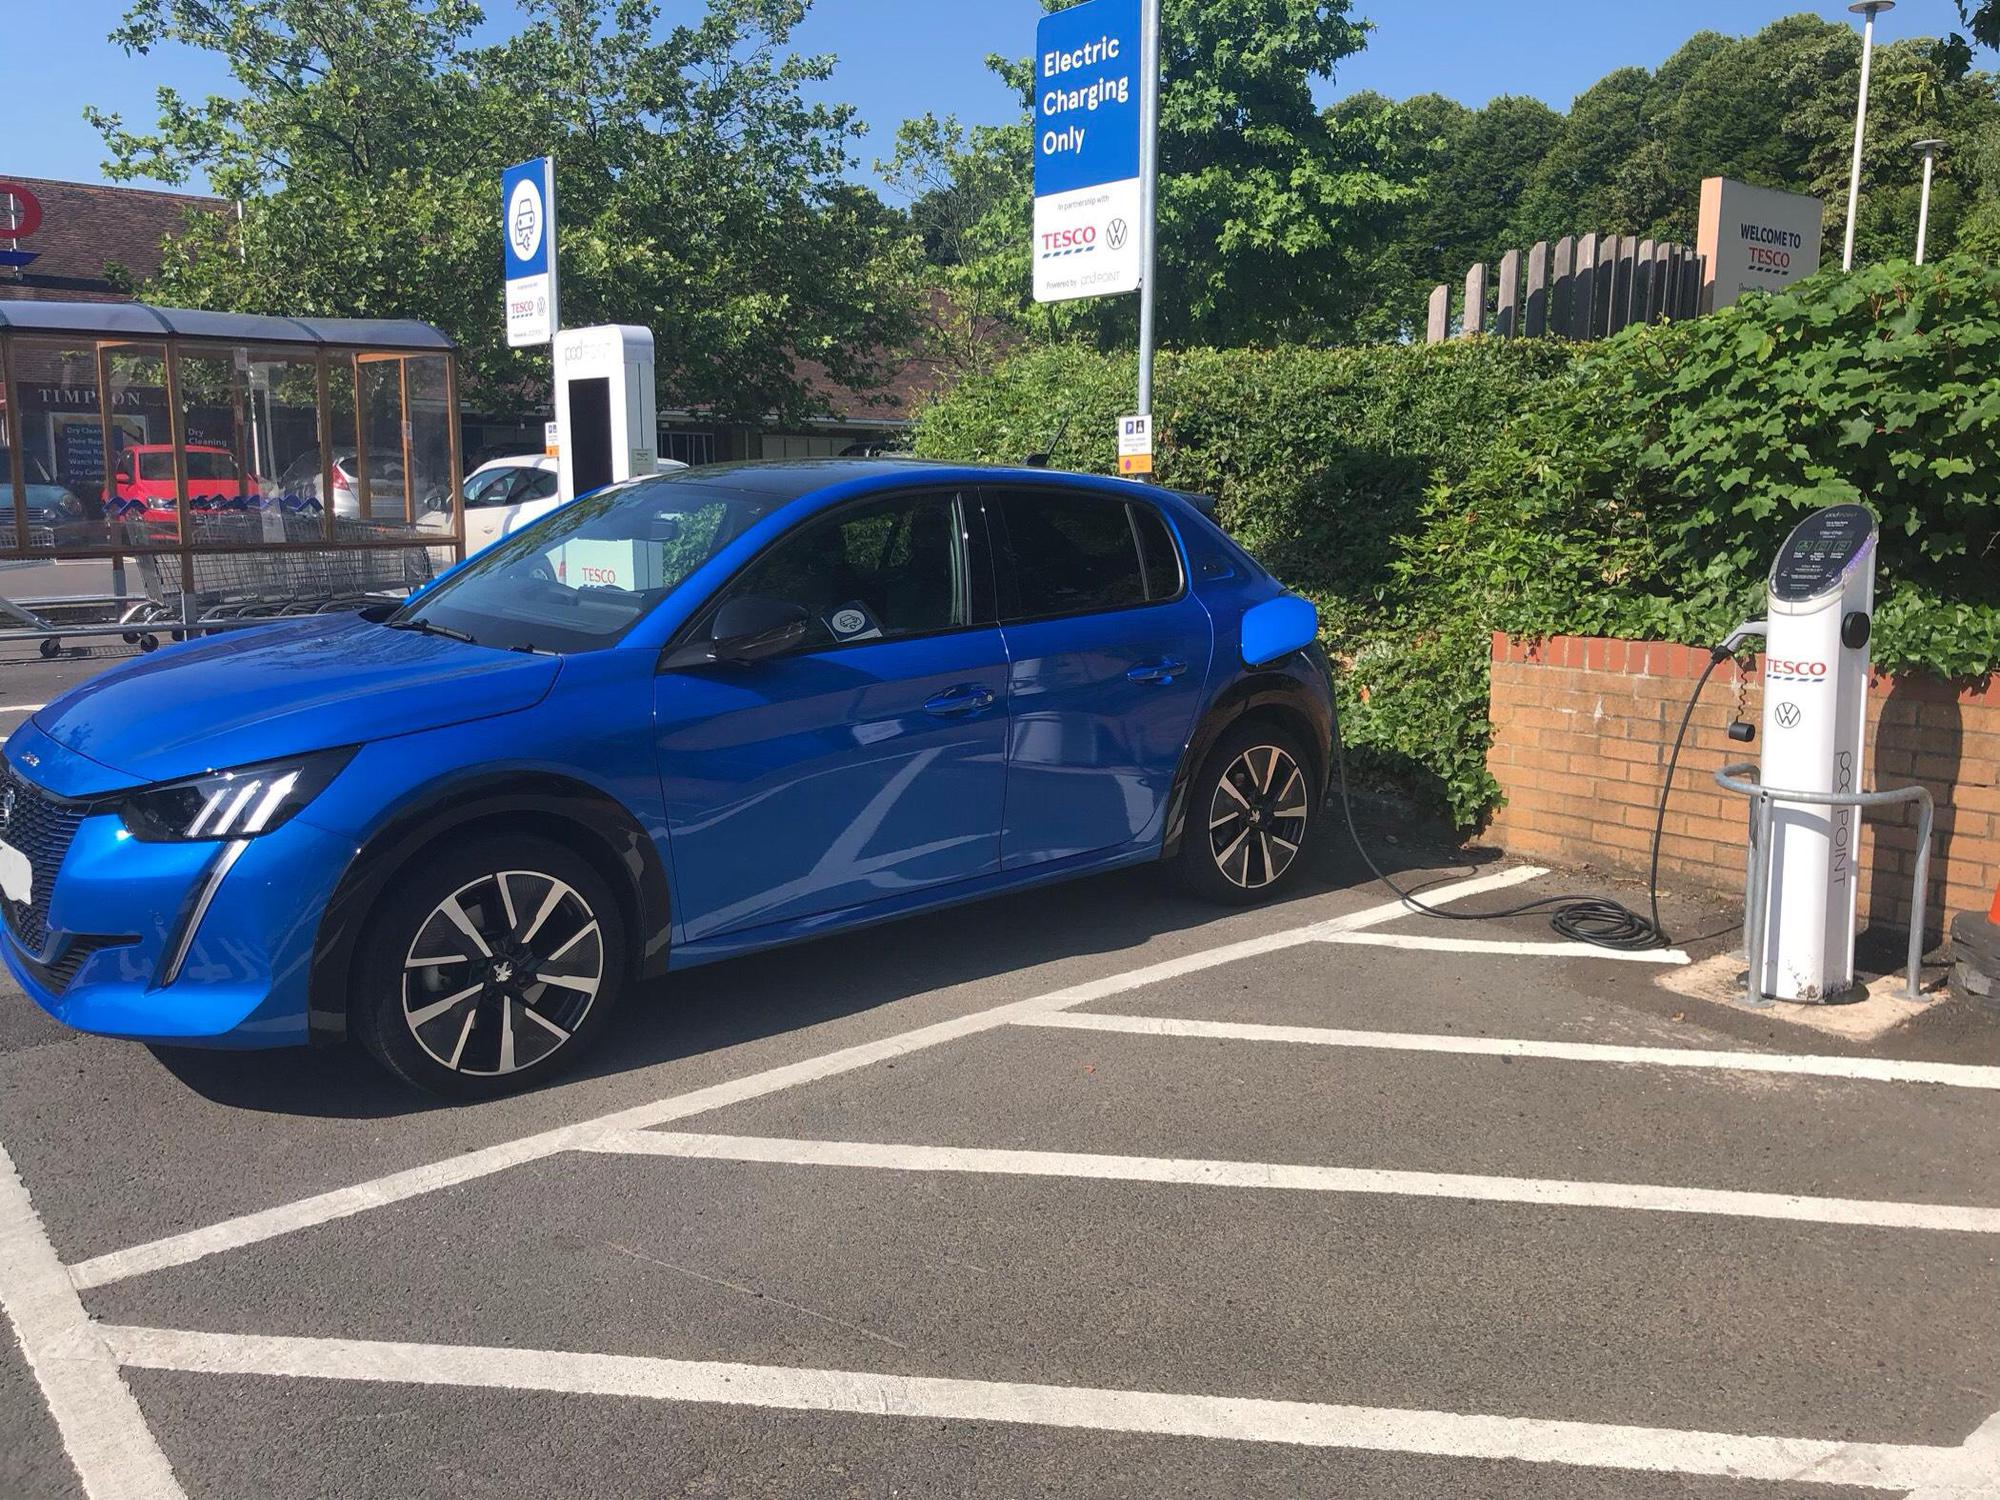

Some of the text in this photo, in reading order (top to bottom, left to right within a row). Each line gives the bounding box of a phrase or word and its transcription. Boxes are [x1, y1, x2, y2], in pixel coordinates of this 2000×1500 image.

[1044, 35, 1120, 78] Electric
[1043, 76, 1129, 116] Charging
[1042, 125, 1086, 155] Only
[1041, 226, 1097, 250] TESCO
[1740, 223, 1802, 249] WELCOME TO
[1748, 246, 1791, 268] TESCO
[511, 300, 535, 313] TESCO
[38, 388, 142, 407] TIMPON
[188, 428, 204, 438] Dry
[188, 437, 227, 447] Cleaning
[582, 567, 616, 584] TESCO
[1767, 658, 1827, 677] TESCO
[1833, 810, 1849, 887] POINT
